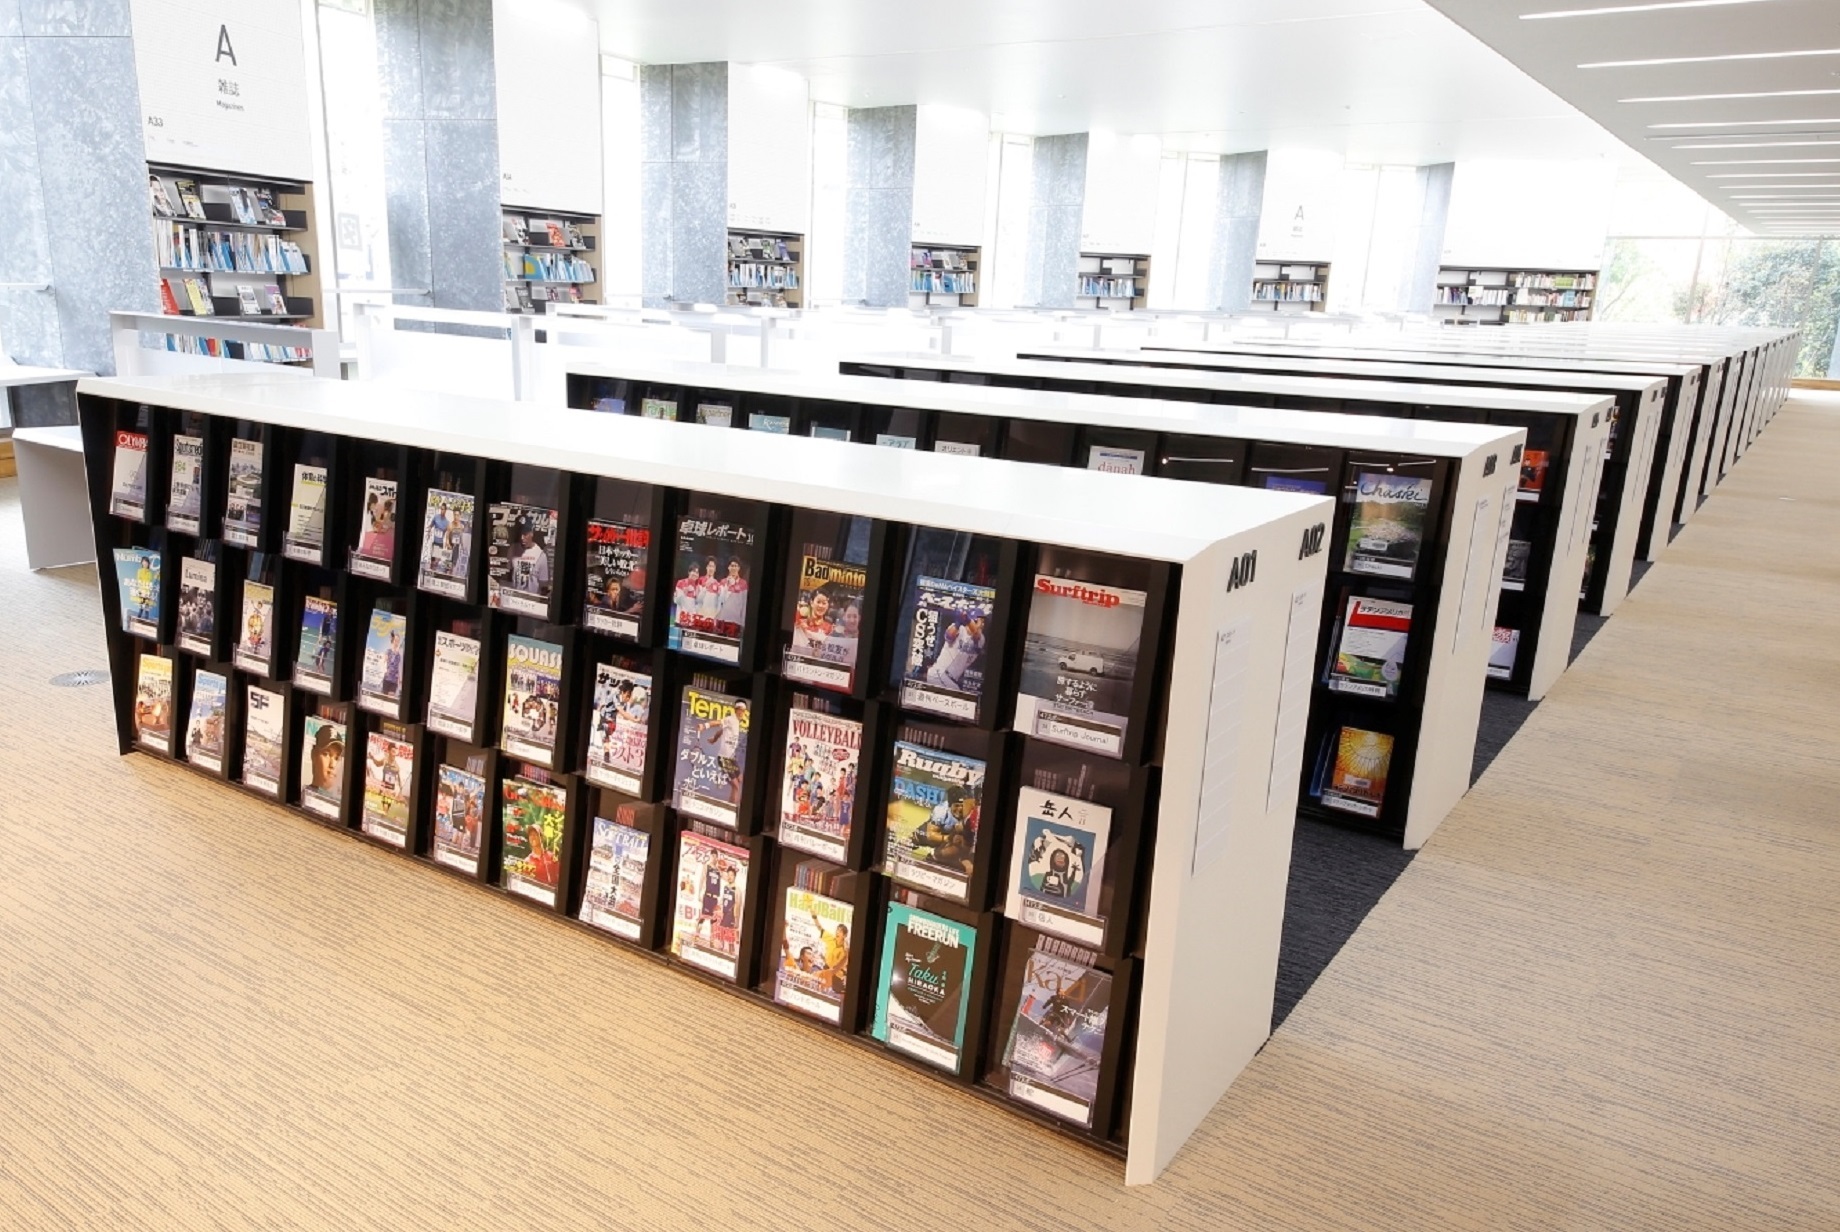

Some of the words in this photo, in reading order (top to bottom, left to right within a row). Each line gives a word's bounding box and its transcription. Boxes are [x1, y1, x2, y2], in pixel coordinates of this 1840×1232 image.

[215, 24, 237, 66] A
[217, 78, 240, 97] 雑誌
[147, 115, 164, 128] A33
[680, 520, 747, 540] 卓球レポート
[1299, 521, 1326, 561] A02
[1227, 549, 1257, 593] A01
[1037, 578, 1120, 608] Surftrip
[689, 691, 751, 728] Tenns
[897, 749, 984, 785] Rugby
[1040, 799, 1073, 821] 岳人
[907, 920, 960, 949] FREERUN
[908, 963, 939, 985] Taku
